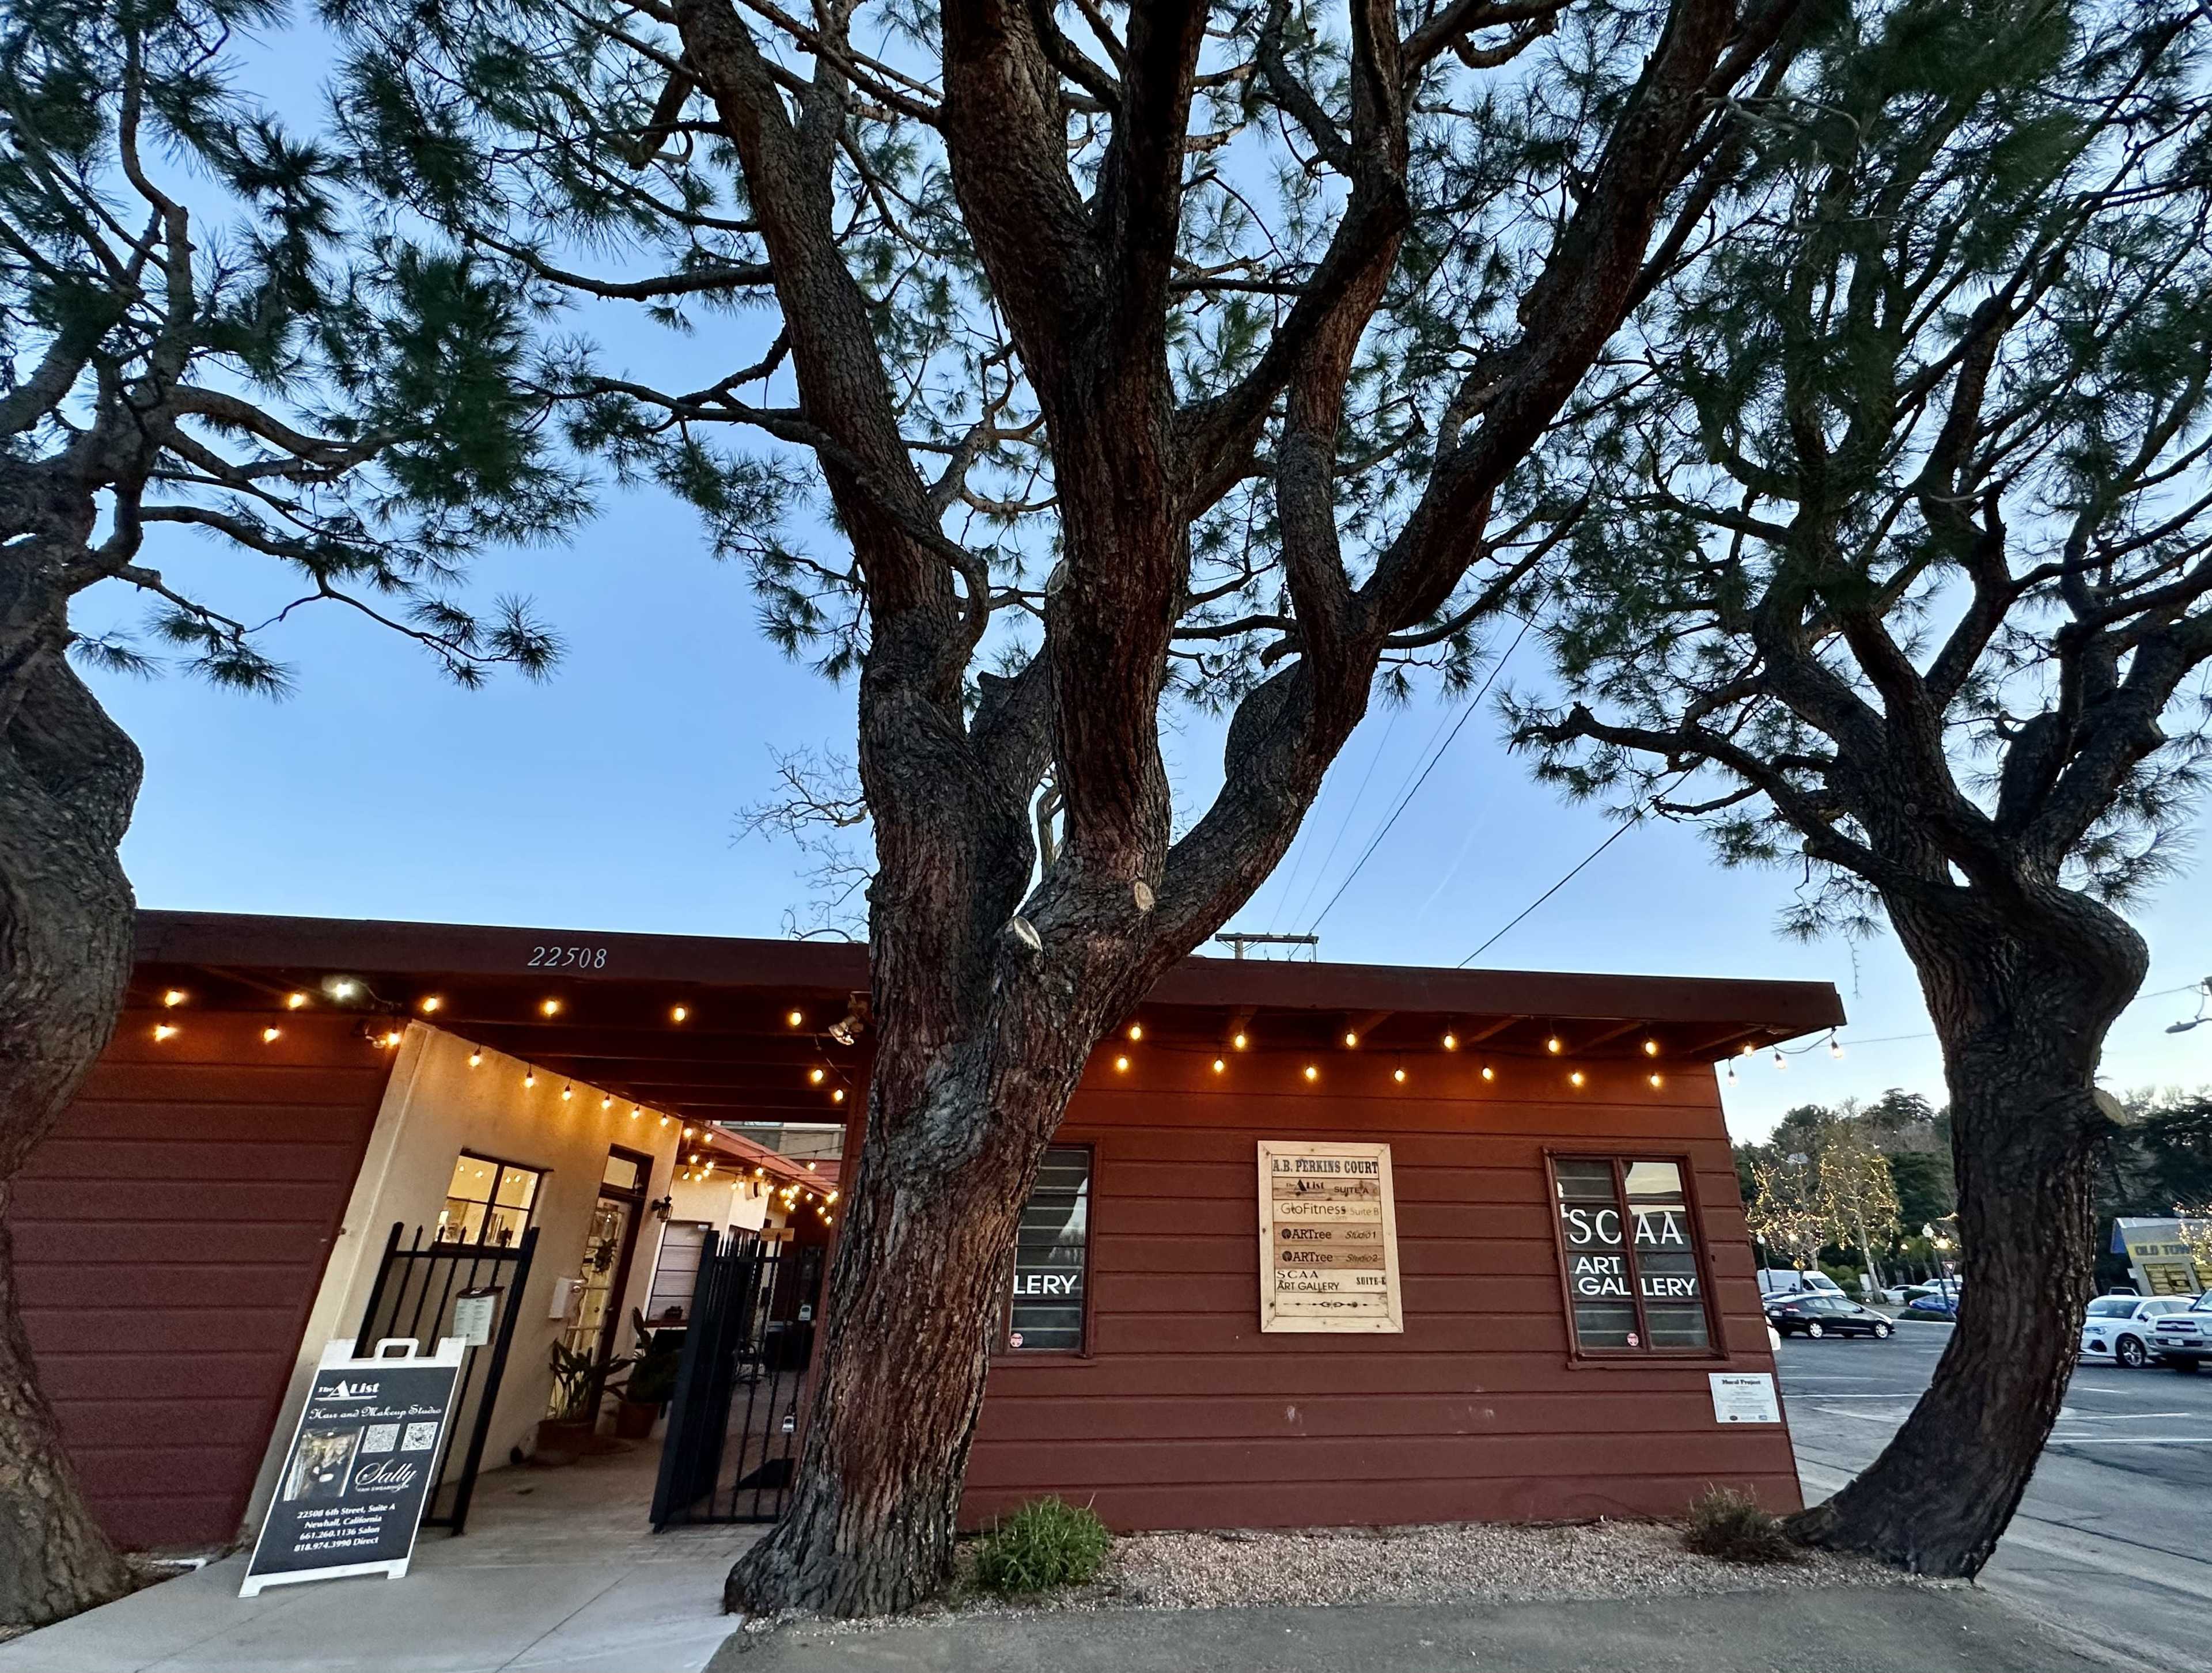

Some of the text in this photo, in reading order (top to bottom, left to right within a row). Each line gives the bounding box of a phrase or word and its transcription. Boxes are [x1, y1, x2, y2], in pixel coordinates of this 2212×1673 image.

[527, 946, 607, 969] 22508
[1272, 1159, 1378, 1174] A.B. PERKINS COURT
[1334, 1186, 1360, 1194] SUITE
[1281, 1202, 1347, 1215] GloFitness
[1350, 1207, 1380, 1216] Suite B
[1569, 1209, 1684, 1245] SCAA
[1291, 1229, 1332, 1239] ARTree
[1293, 1252, 1334, 1262] ARTree
[1575, 1257, 1620, 1274] ART
[1277, 1270, 1319, 1279] SCAA
[1277, 1281, 1340, 1291] ART GALLERY
[328, 1380, 350, 1397] A
[350, 1382, 380, 1394] List
[340, 1409, 359, 1418] and
[361, 1406, 406, 1420] Makeup
[408, 1404, 442, 1416] Studio
[355, 1459, 418, 1493] Sally
[325, 1508, 339, 1516] 6th
[340, 1507, 366, 1515] Street,
[368, 1504, 388, 1512] Suite
[343, 1515, 382, 1526] California
[300, 1527, 380, 1541] 661.260.1136 Salon
[353, 1537, 378, 1546] Direct
